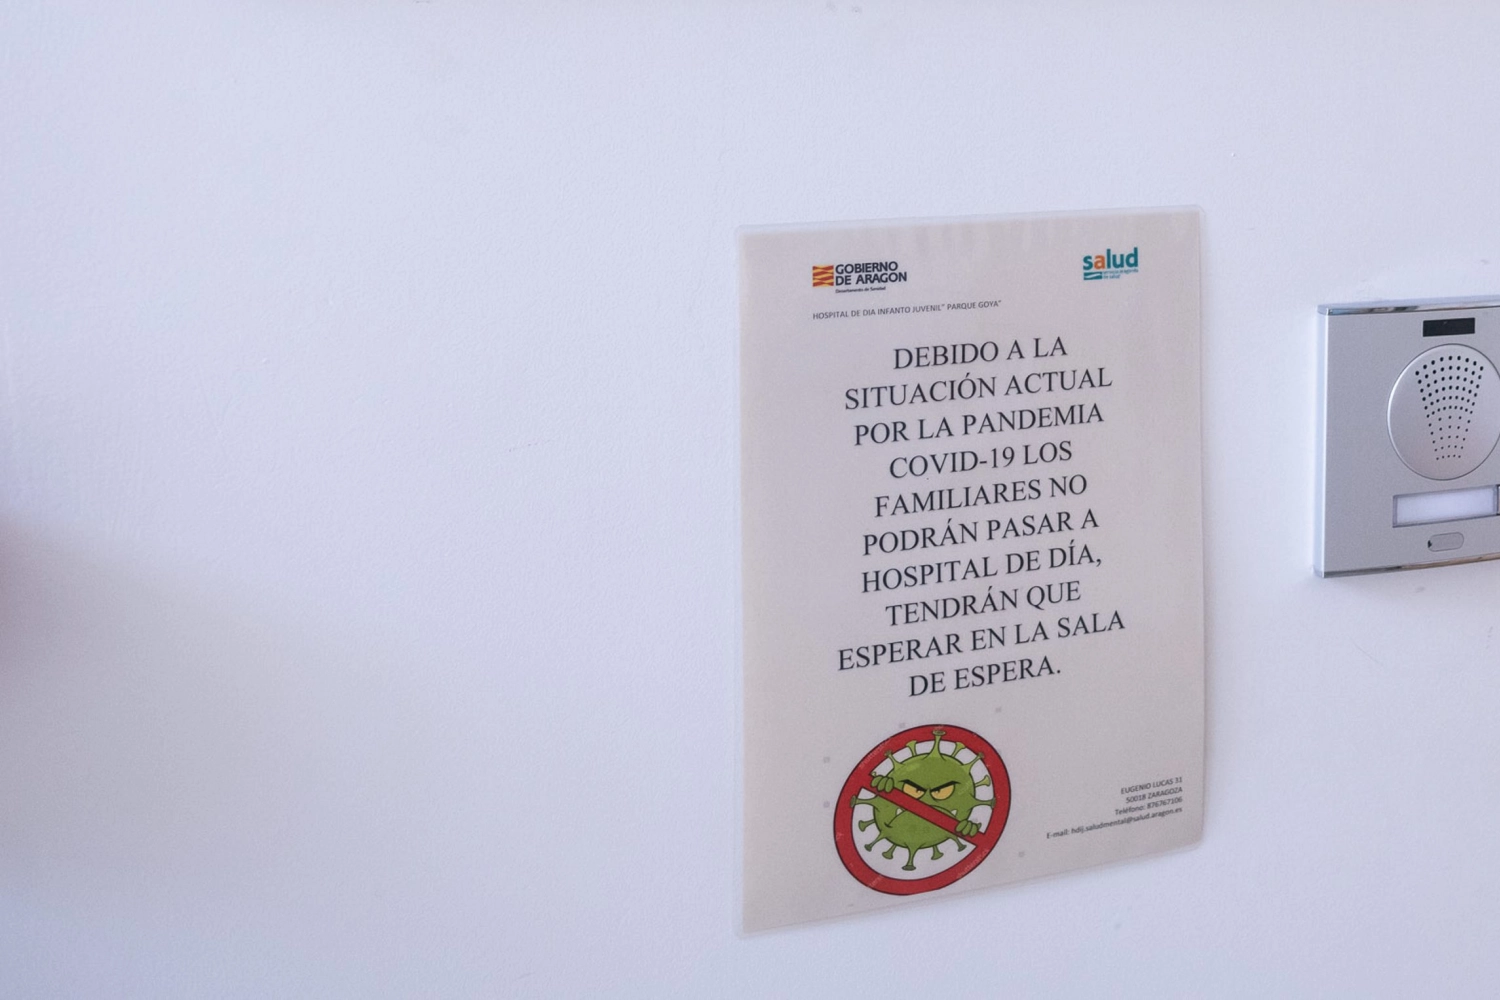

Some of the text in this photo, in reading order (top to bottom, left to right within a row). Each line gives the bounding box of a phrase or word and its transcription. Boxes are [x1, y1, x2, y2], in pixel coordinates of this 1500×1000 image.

[835, 261, 898, 275] GOBIERNO
[1083, 247, 1138, 270] salud
[836, 272, 907, 286] DE ARAGON
[812, 311, 849, 320] HOSPITAL
[878, 306, 911, 315] INFANTO
[947, 302, 977, 310] PARQUE
[894, 336, 1068, 369] DEBIDO A LA
[845, 368, 1113, 410] SITUACIÓN ACTUAL
[854, 403, 1105, 446] POR LA PANDEMIA
[890, 441, 1073, 479] COVID-19 LOS
[875, 474, 1088, 517] FAMILIARES NO
[863, 509, 1099, 556] PODRÁN PASAR A
[862, 539, 1102, 593] HOSPITAL DE DÍA,
[885, 581, 1082, 627] TENDRÁN QUE
[838, 610, 1126, 671] ESPERAR EN LA SALA
[909, 655, 1061, 697] DE ESPERA.
[1121, 783, 1151, 794] EUGENIO
[1153, 778, 1174, 788] LUCAS
[1126, 787, 1183, 803] 50018 ZARAGOZA
[1115, 805, 1145, 815] Teléfono:
[1046, 828, 1069, 839] E-mail:
